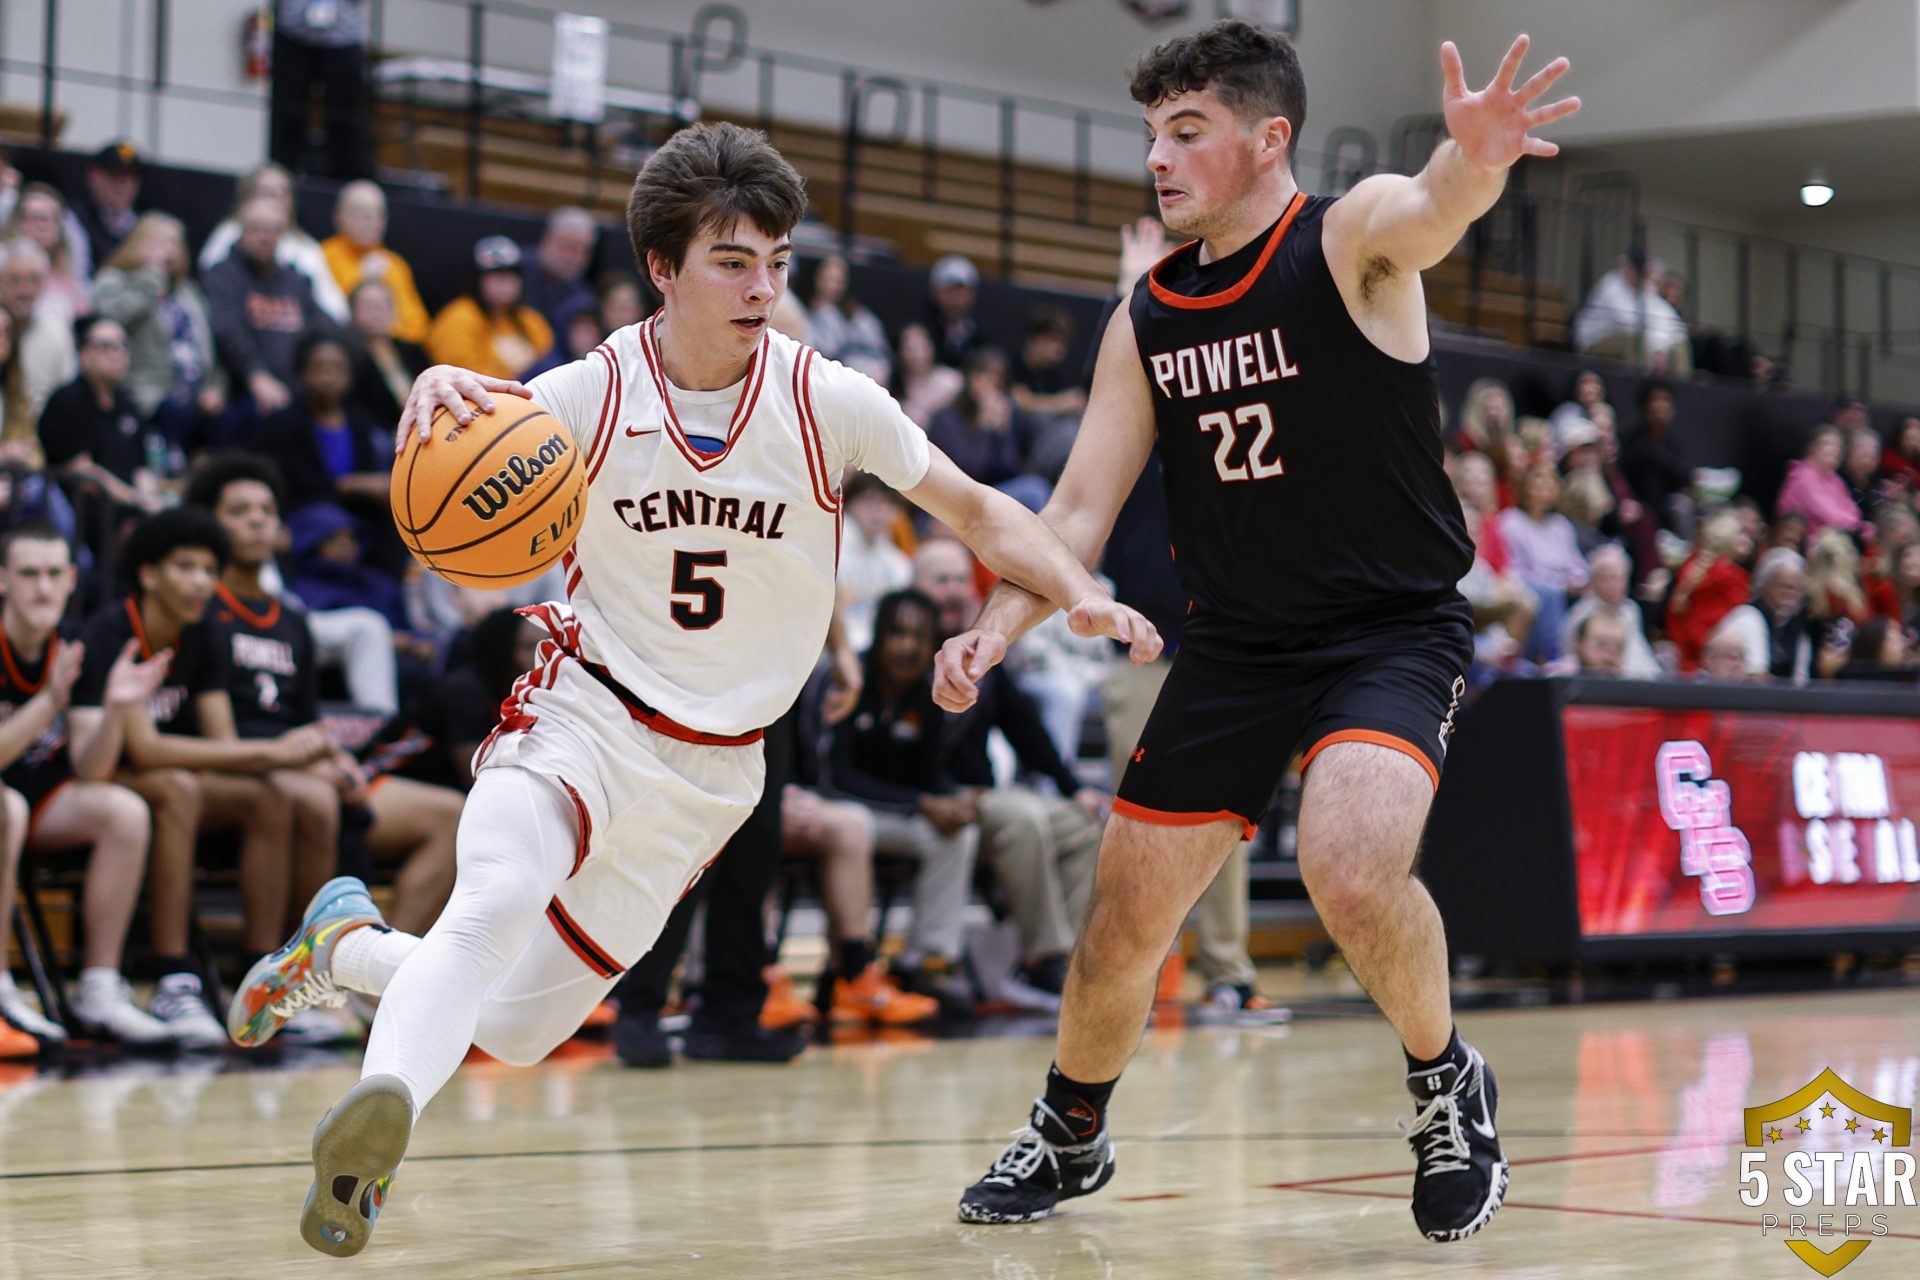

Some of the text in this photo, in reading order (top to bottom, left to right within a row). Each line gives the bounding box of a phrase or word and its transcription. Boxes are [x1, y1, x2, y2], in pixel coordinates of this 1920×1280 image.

[1149, 327, 1300, 399] POWELL
[461, 432, 569, 522] Wilson
[1198, 402, 1285, 482] 22
[612, 489, 787, 540] CENTRAL
[670, 549, 728, 631] 5
